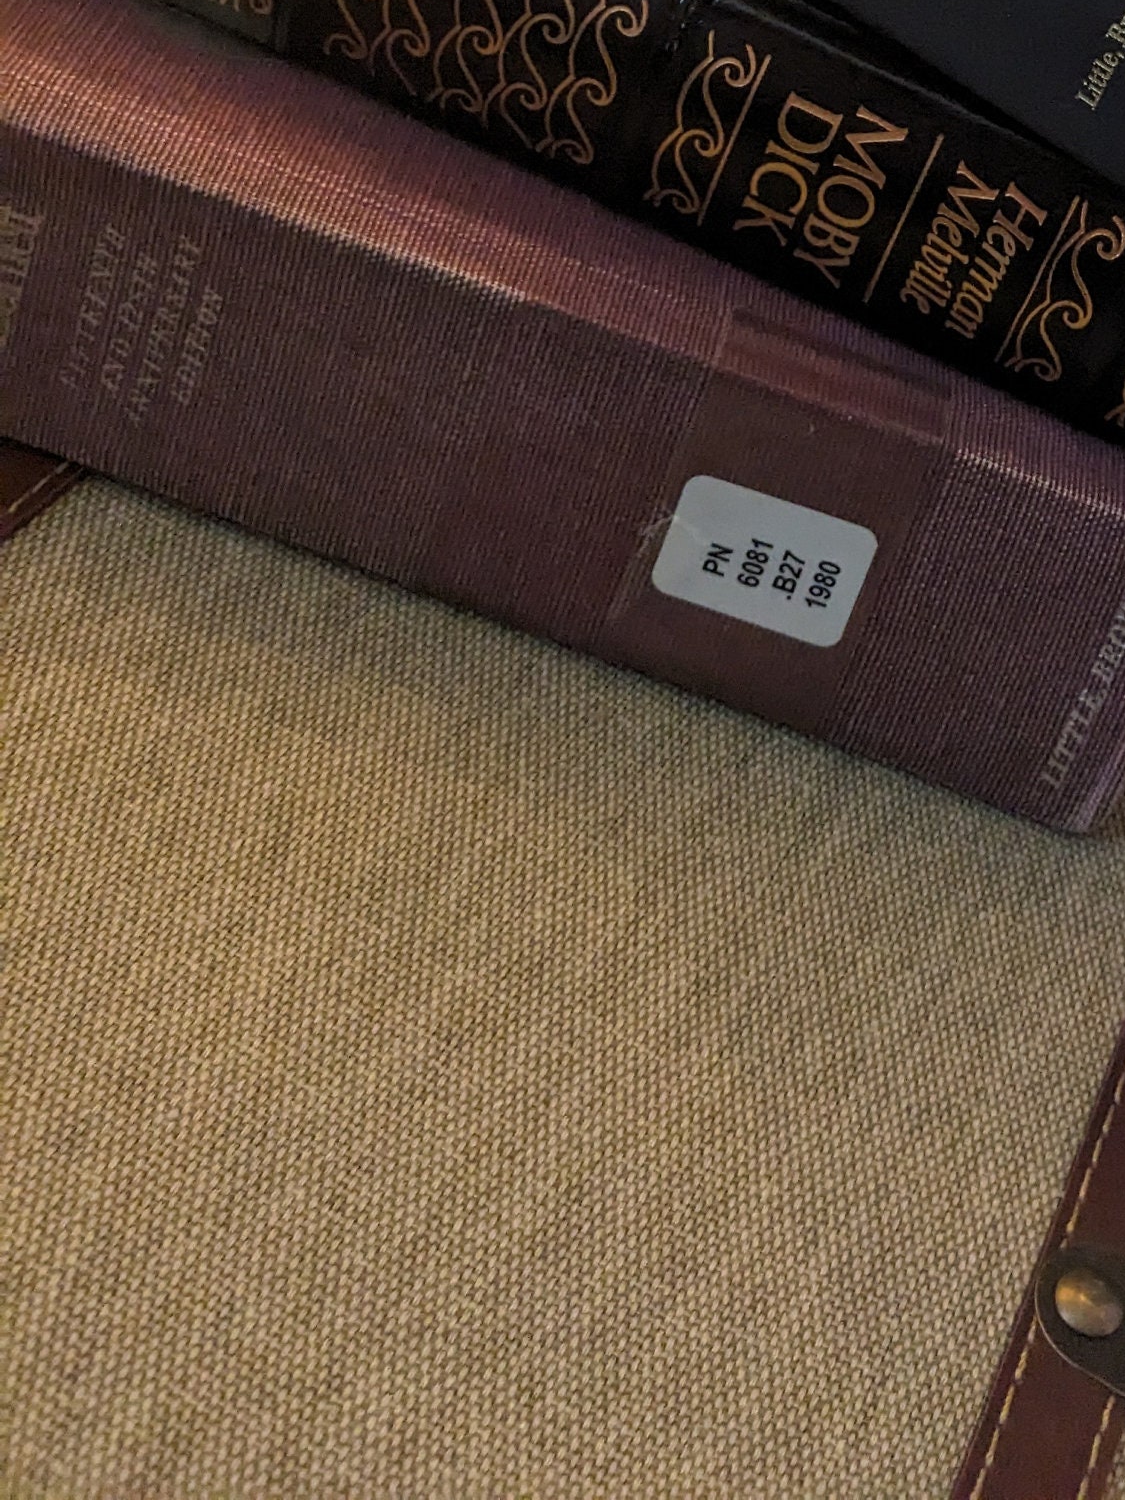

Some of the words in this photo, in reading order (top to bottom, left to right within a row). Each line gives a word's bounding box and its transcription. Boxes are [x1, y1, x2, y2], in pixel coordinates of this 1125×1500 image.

[1073, 43, 1125, 112] Little,
[732, 90, 845, 248] DICK
[792, 105, 909, 290] MOBY
[901, 160, 1000, 316] Melville
[943, 181, 1049, 340] Herman
[701, 542, 734, 578] PN
[736, 537, 775, 589] 6081
[771, 550, 808, 601] .B27
[804, 560, 842, 610] 1980
